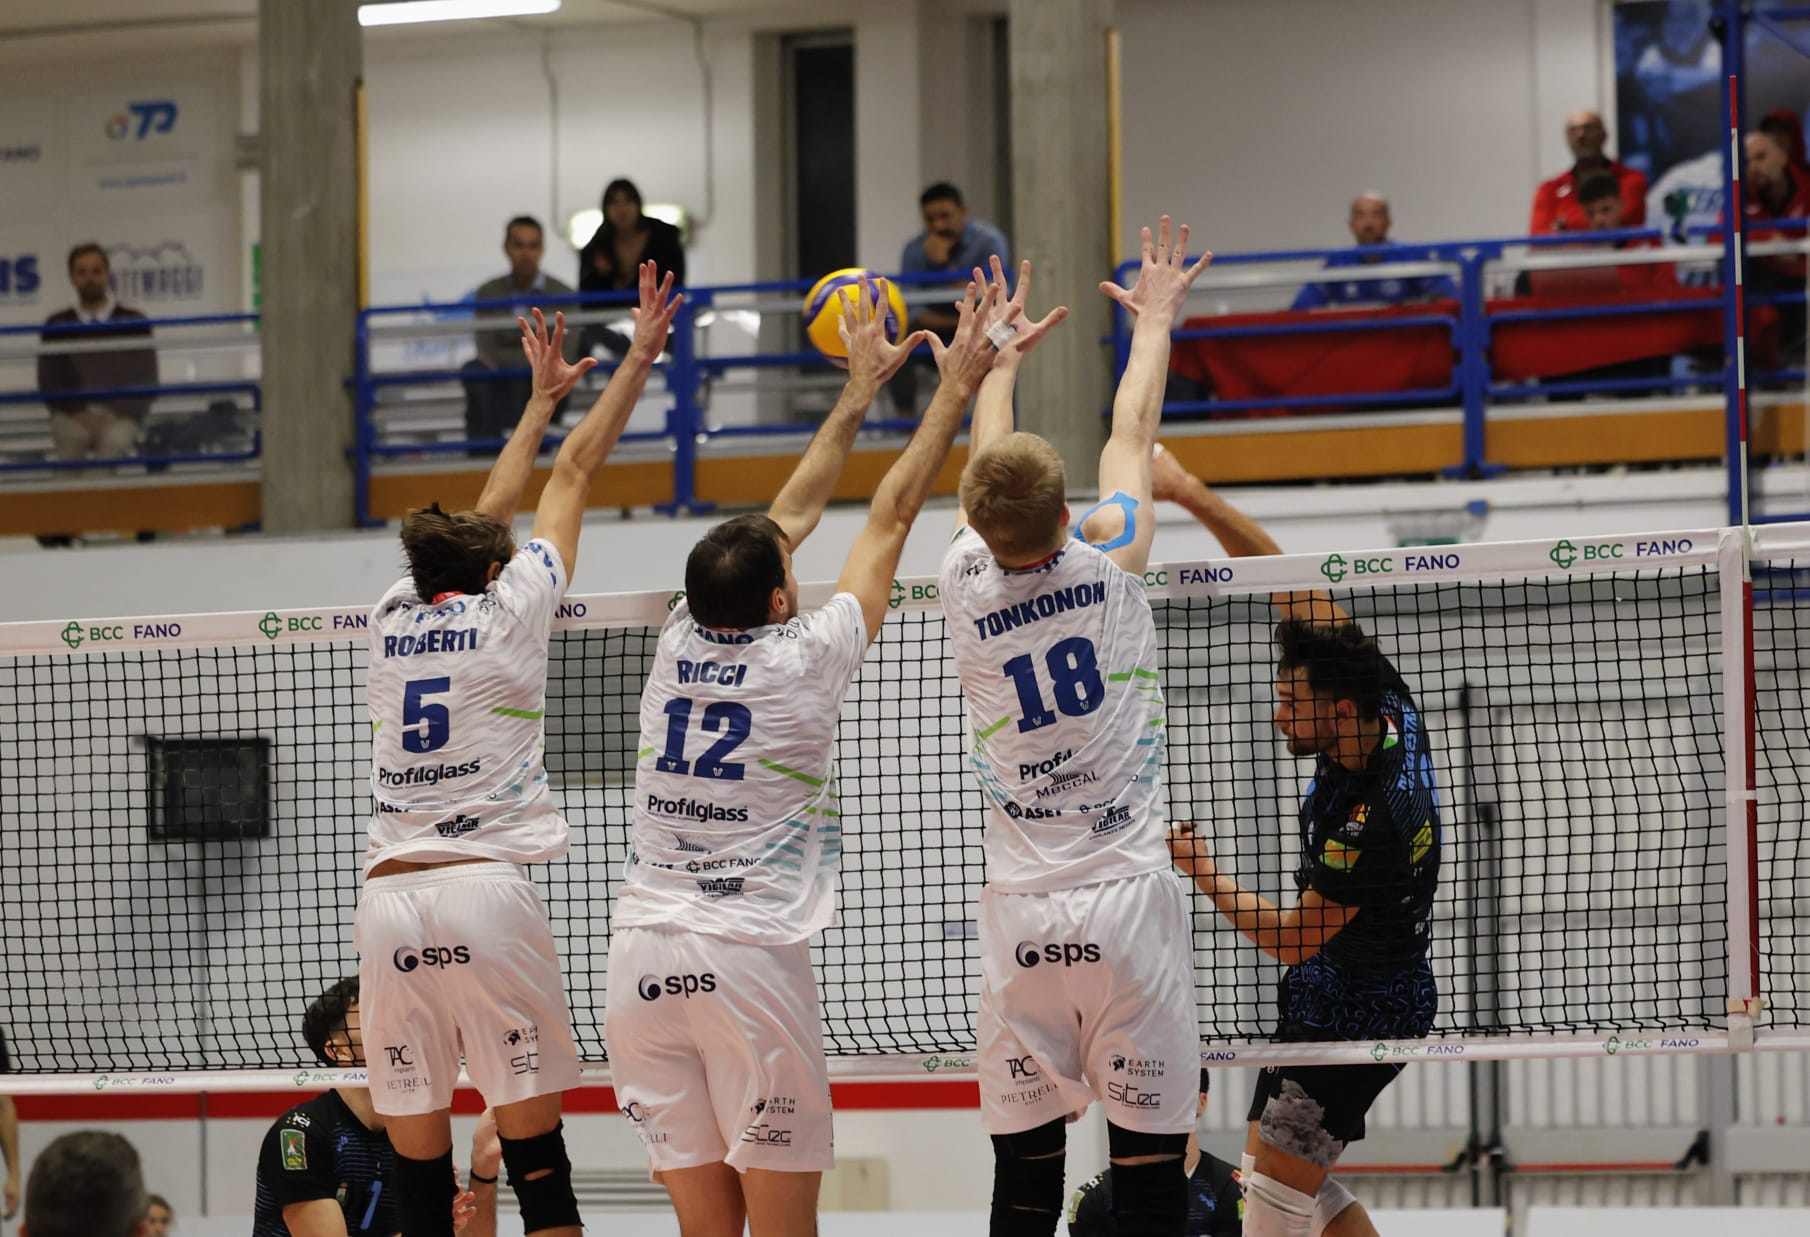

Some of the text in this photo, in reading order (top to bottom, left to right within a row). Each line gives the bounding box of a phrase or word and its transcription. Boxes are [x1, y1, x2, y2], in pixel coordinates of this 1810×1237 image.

[1584, 539, 1692, 560] BCC FANO
[1354, 554, 1460, 574] BCC FANO
[1144, 567, 1233, 587] CC FANO
[911, 584, 939, 600] BC
[554, 603, 587, 619] NO
[89, 623, 181, 641] BCC FANO
[288, 614, 368, 631] BCC FAN
[384, 628, 478, 659] ROBERTI
[677, 659, 748, 688] RICCI
[1003, 636, 1106, 734] 18
[402, 676, 451, 754] 5
[655, 697, 752, 781] 12
[379, 760, 481, 786] Profilglass
[647, 794, 749, 823] Profilglass
[703, 860, 727, 871] BCC
[422, 945, 471, 969] sps
[1044, 942, 1101, 967] sps
[664, 972, 717, 998] sps
[1392, 1045, 1464, 1057] BCC FANO
[1624, 1038, 1700, 1049] BCC FANO
[384, 1045, 413, 1066] TAC
[943, 1058, 971, 1067] BCC
[1128, 1059, 1165, 1068] EARTH
[312, 1071, 369, 1082] BCC FAN
[1005, 1055, 1037, 1079] TAC
[1127, 1068, 1164, 1077] SYSTEM
[111, 1076, 176, 1087] BCC FANO
[766, 1106, 795, 1115] STEM
